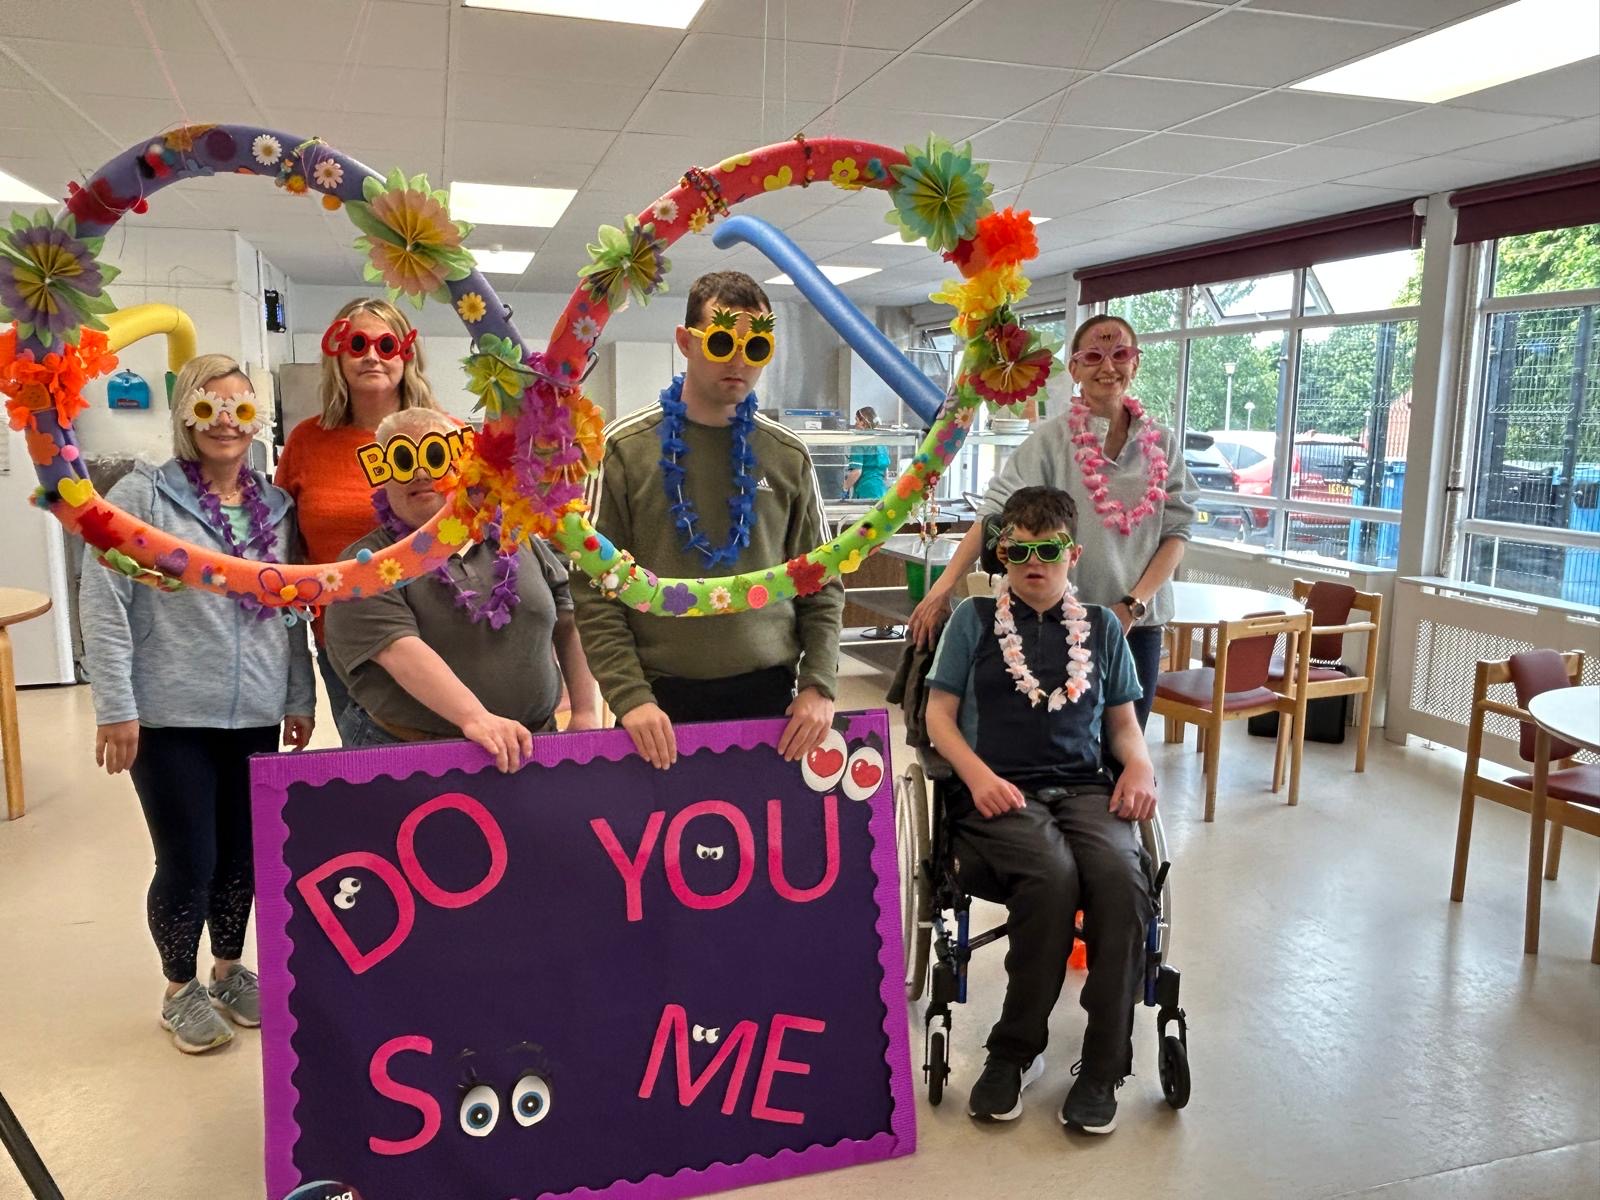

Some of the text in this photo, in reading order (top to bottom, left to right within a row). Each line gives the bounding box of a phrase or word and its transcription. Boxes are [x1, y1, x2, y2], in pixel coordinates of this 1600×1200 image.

[296, 792, 840, 975] DO YOU
[639, 1003, 825, 1125] ME
